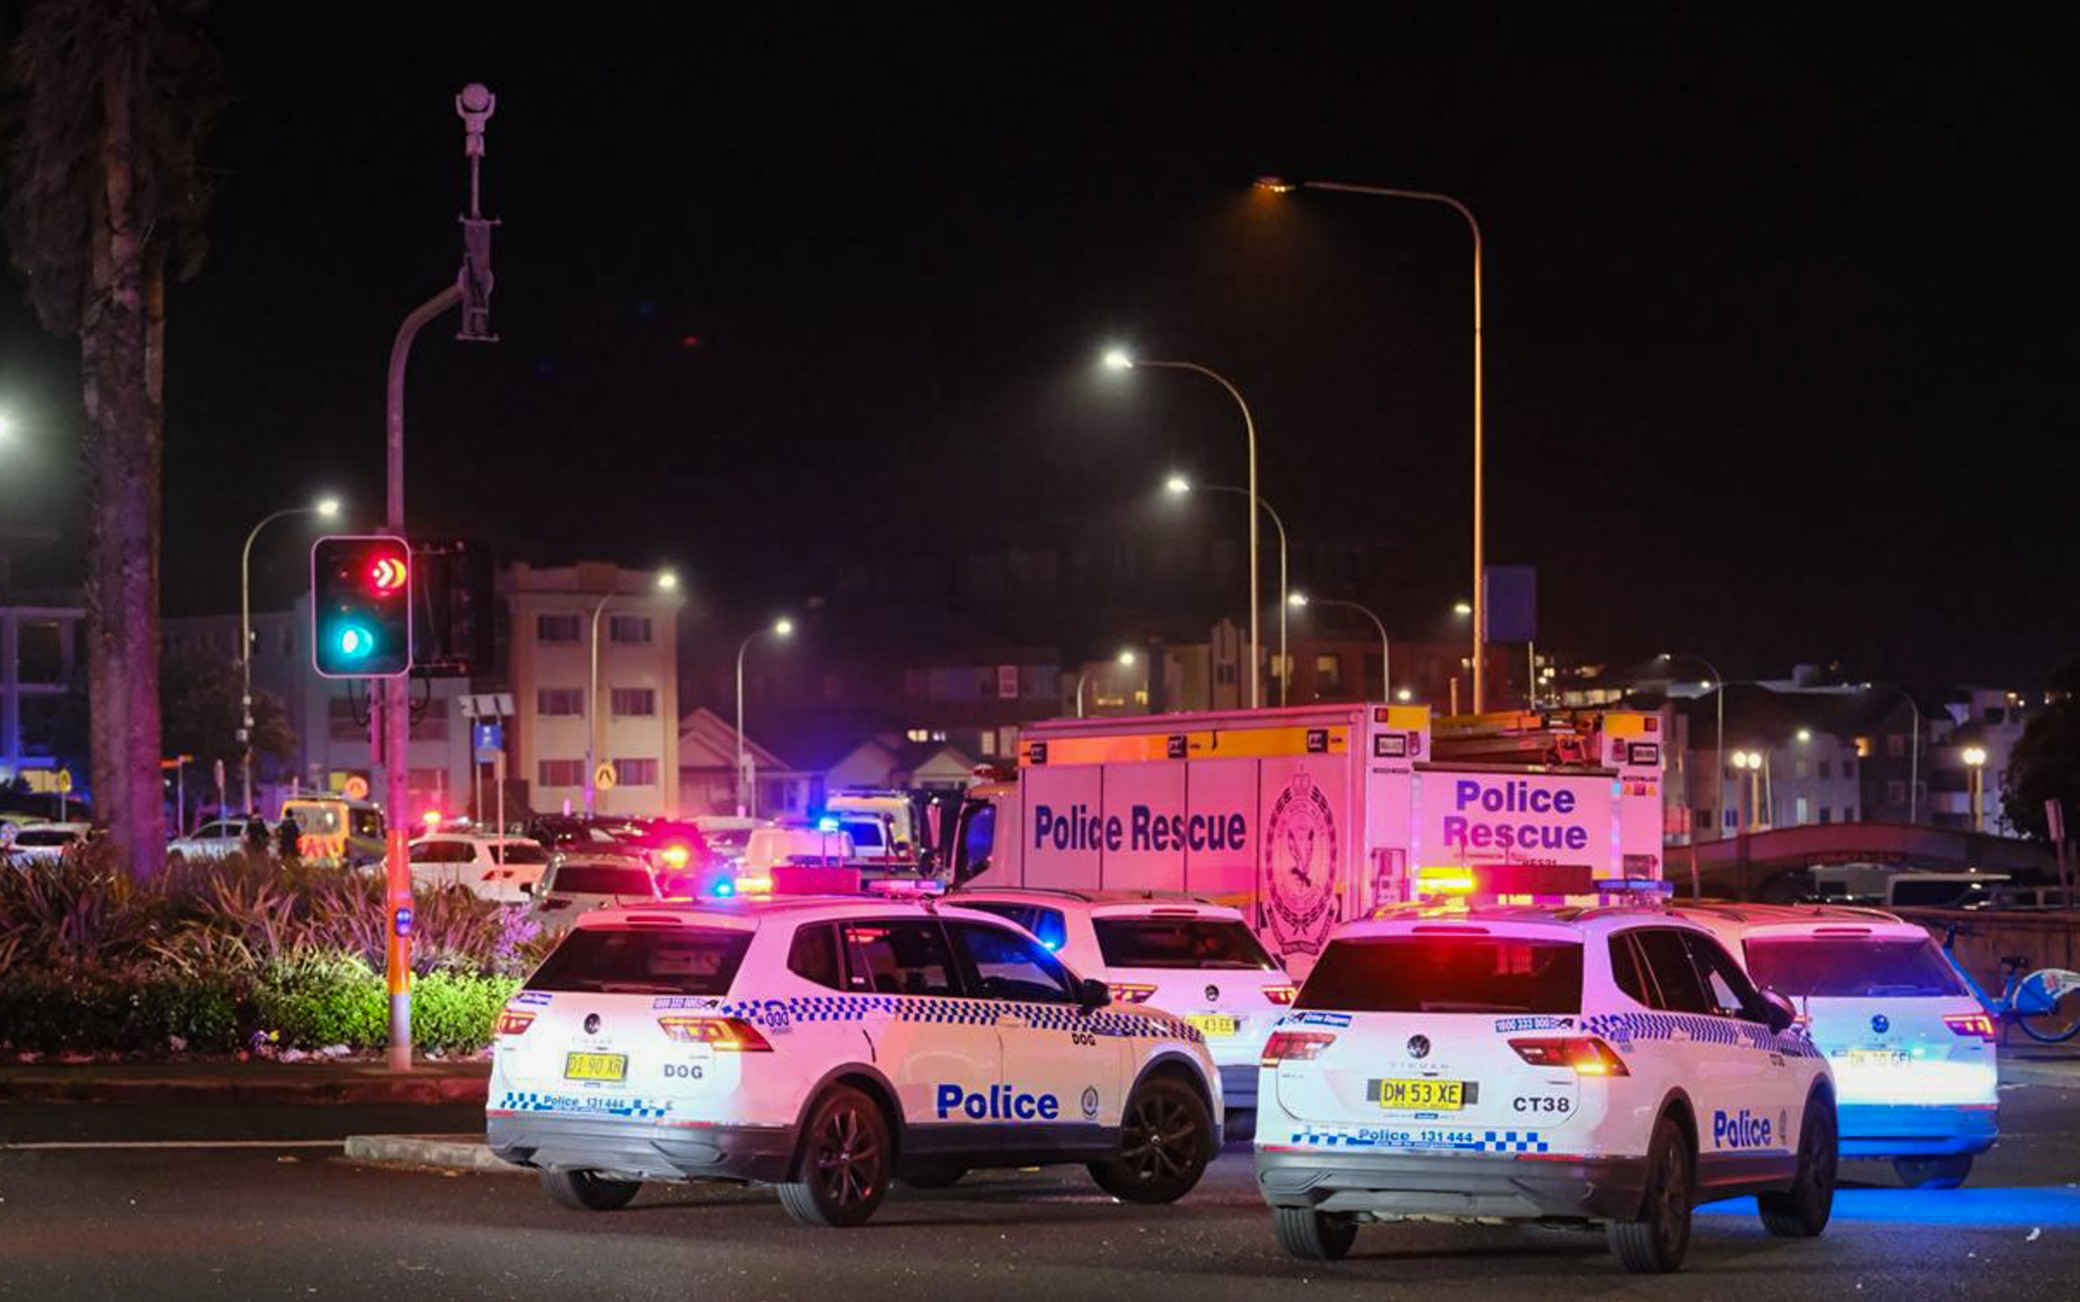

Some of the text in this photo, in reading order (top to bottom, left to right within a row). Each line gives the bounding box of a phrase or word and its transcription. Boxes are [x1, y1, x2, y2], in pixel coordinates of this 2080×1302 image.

[1456, 780, 1575, 813] Police
[1035, 804, 1246, 851] Police Rescue
[1444, 816, 1588, 850] Rescue
[1071, 1033, 1096, 1046] DOG
[664, 1064, 703, 1079] DOG
[544, 1095, 579, 1107] Police
[937, 1084, 1059, 1119] Police
[1384, 1082, 1460, 1104] DM 53 XE
[1513, 1097, 1570, 1113] CT38
[1359, 1128, 1410, 1142] Police
[1714, 1109, 1772, 1148] Police
